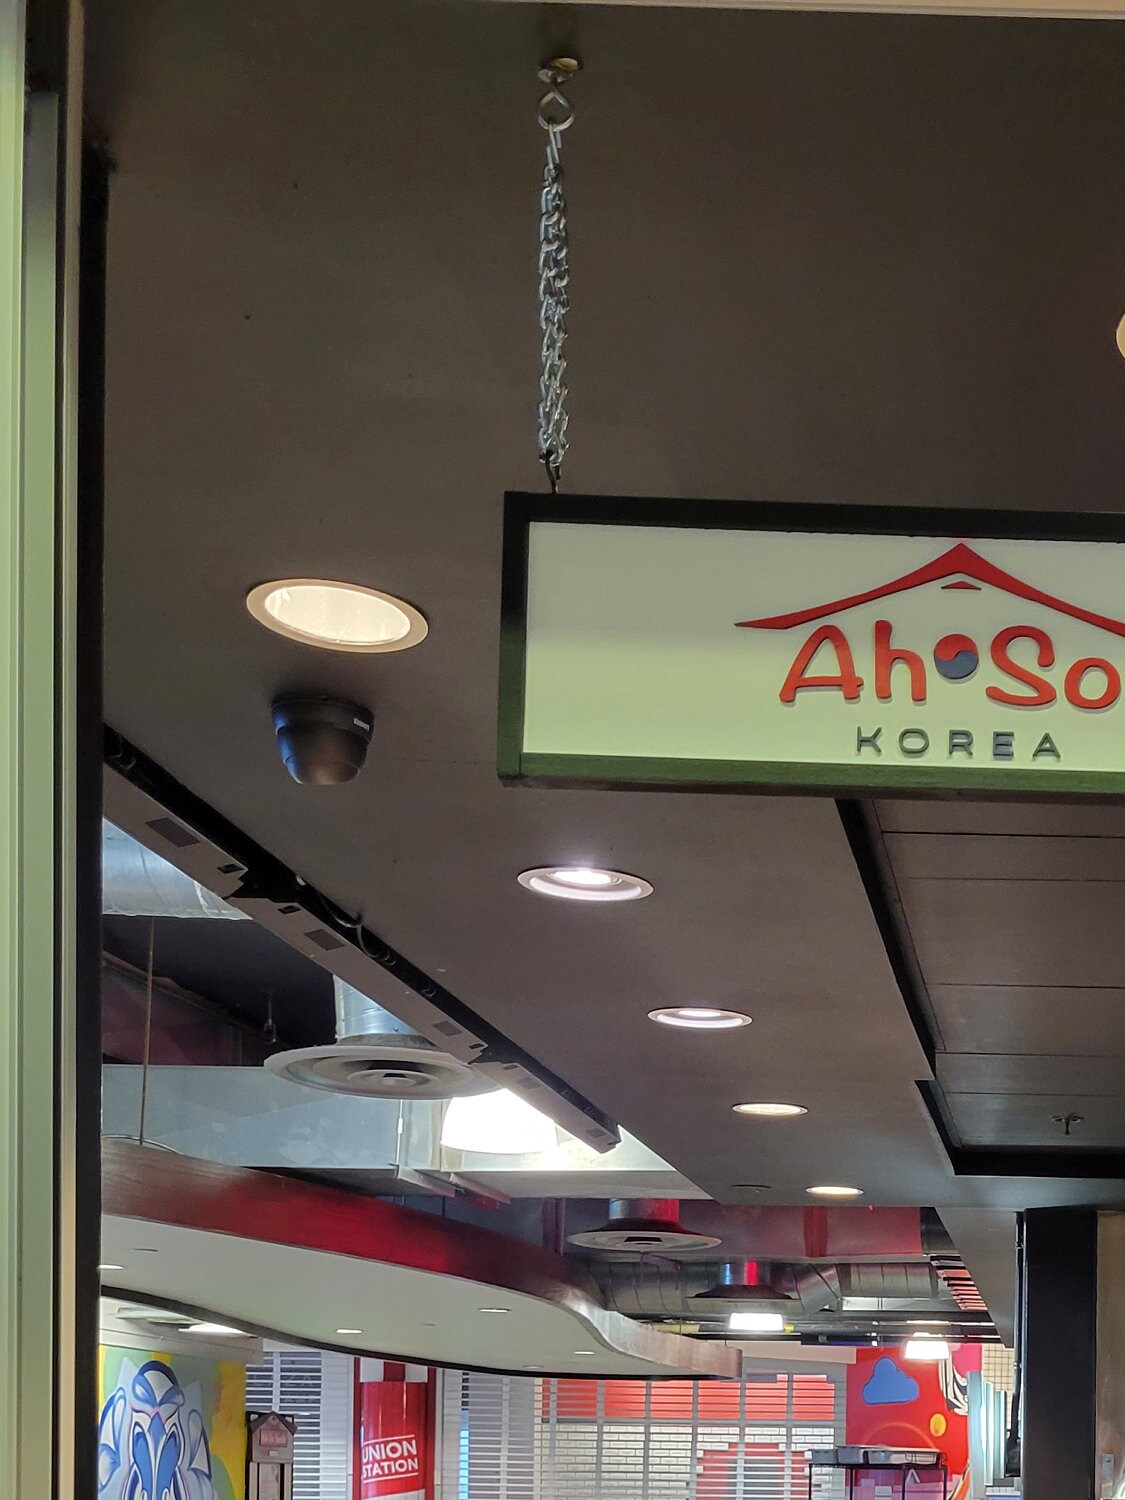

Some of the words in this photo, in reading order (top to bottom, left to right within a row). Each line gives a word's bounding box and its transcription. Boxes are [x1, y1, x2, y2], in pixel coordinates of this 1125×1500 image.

[779, 620, 927, 702] Ah
[985, 625, 1121, 709] So
[856, 726, 1061, 760] KOREA
[362, 1439, 417, 1463] UNION
[362, 1457, 419, 1478] STATION
